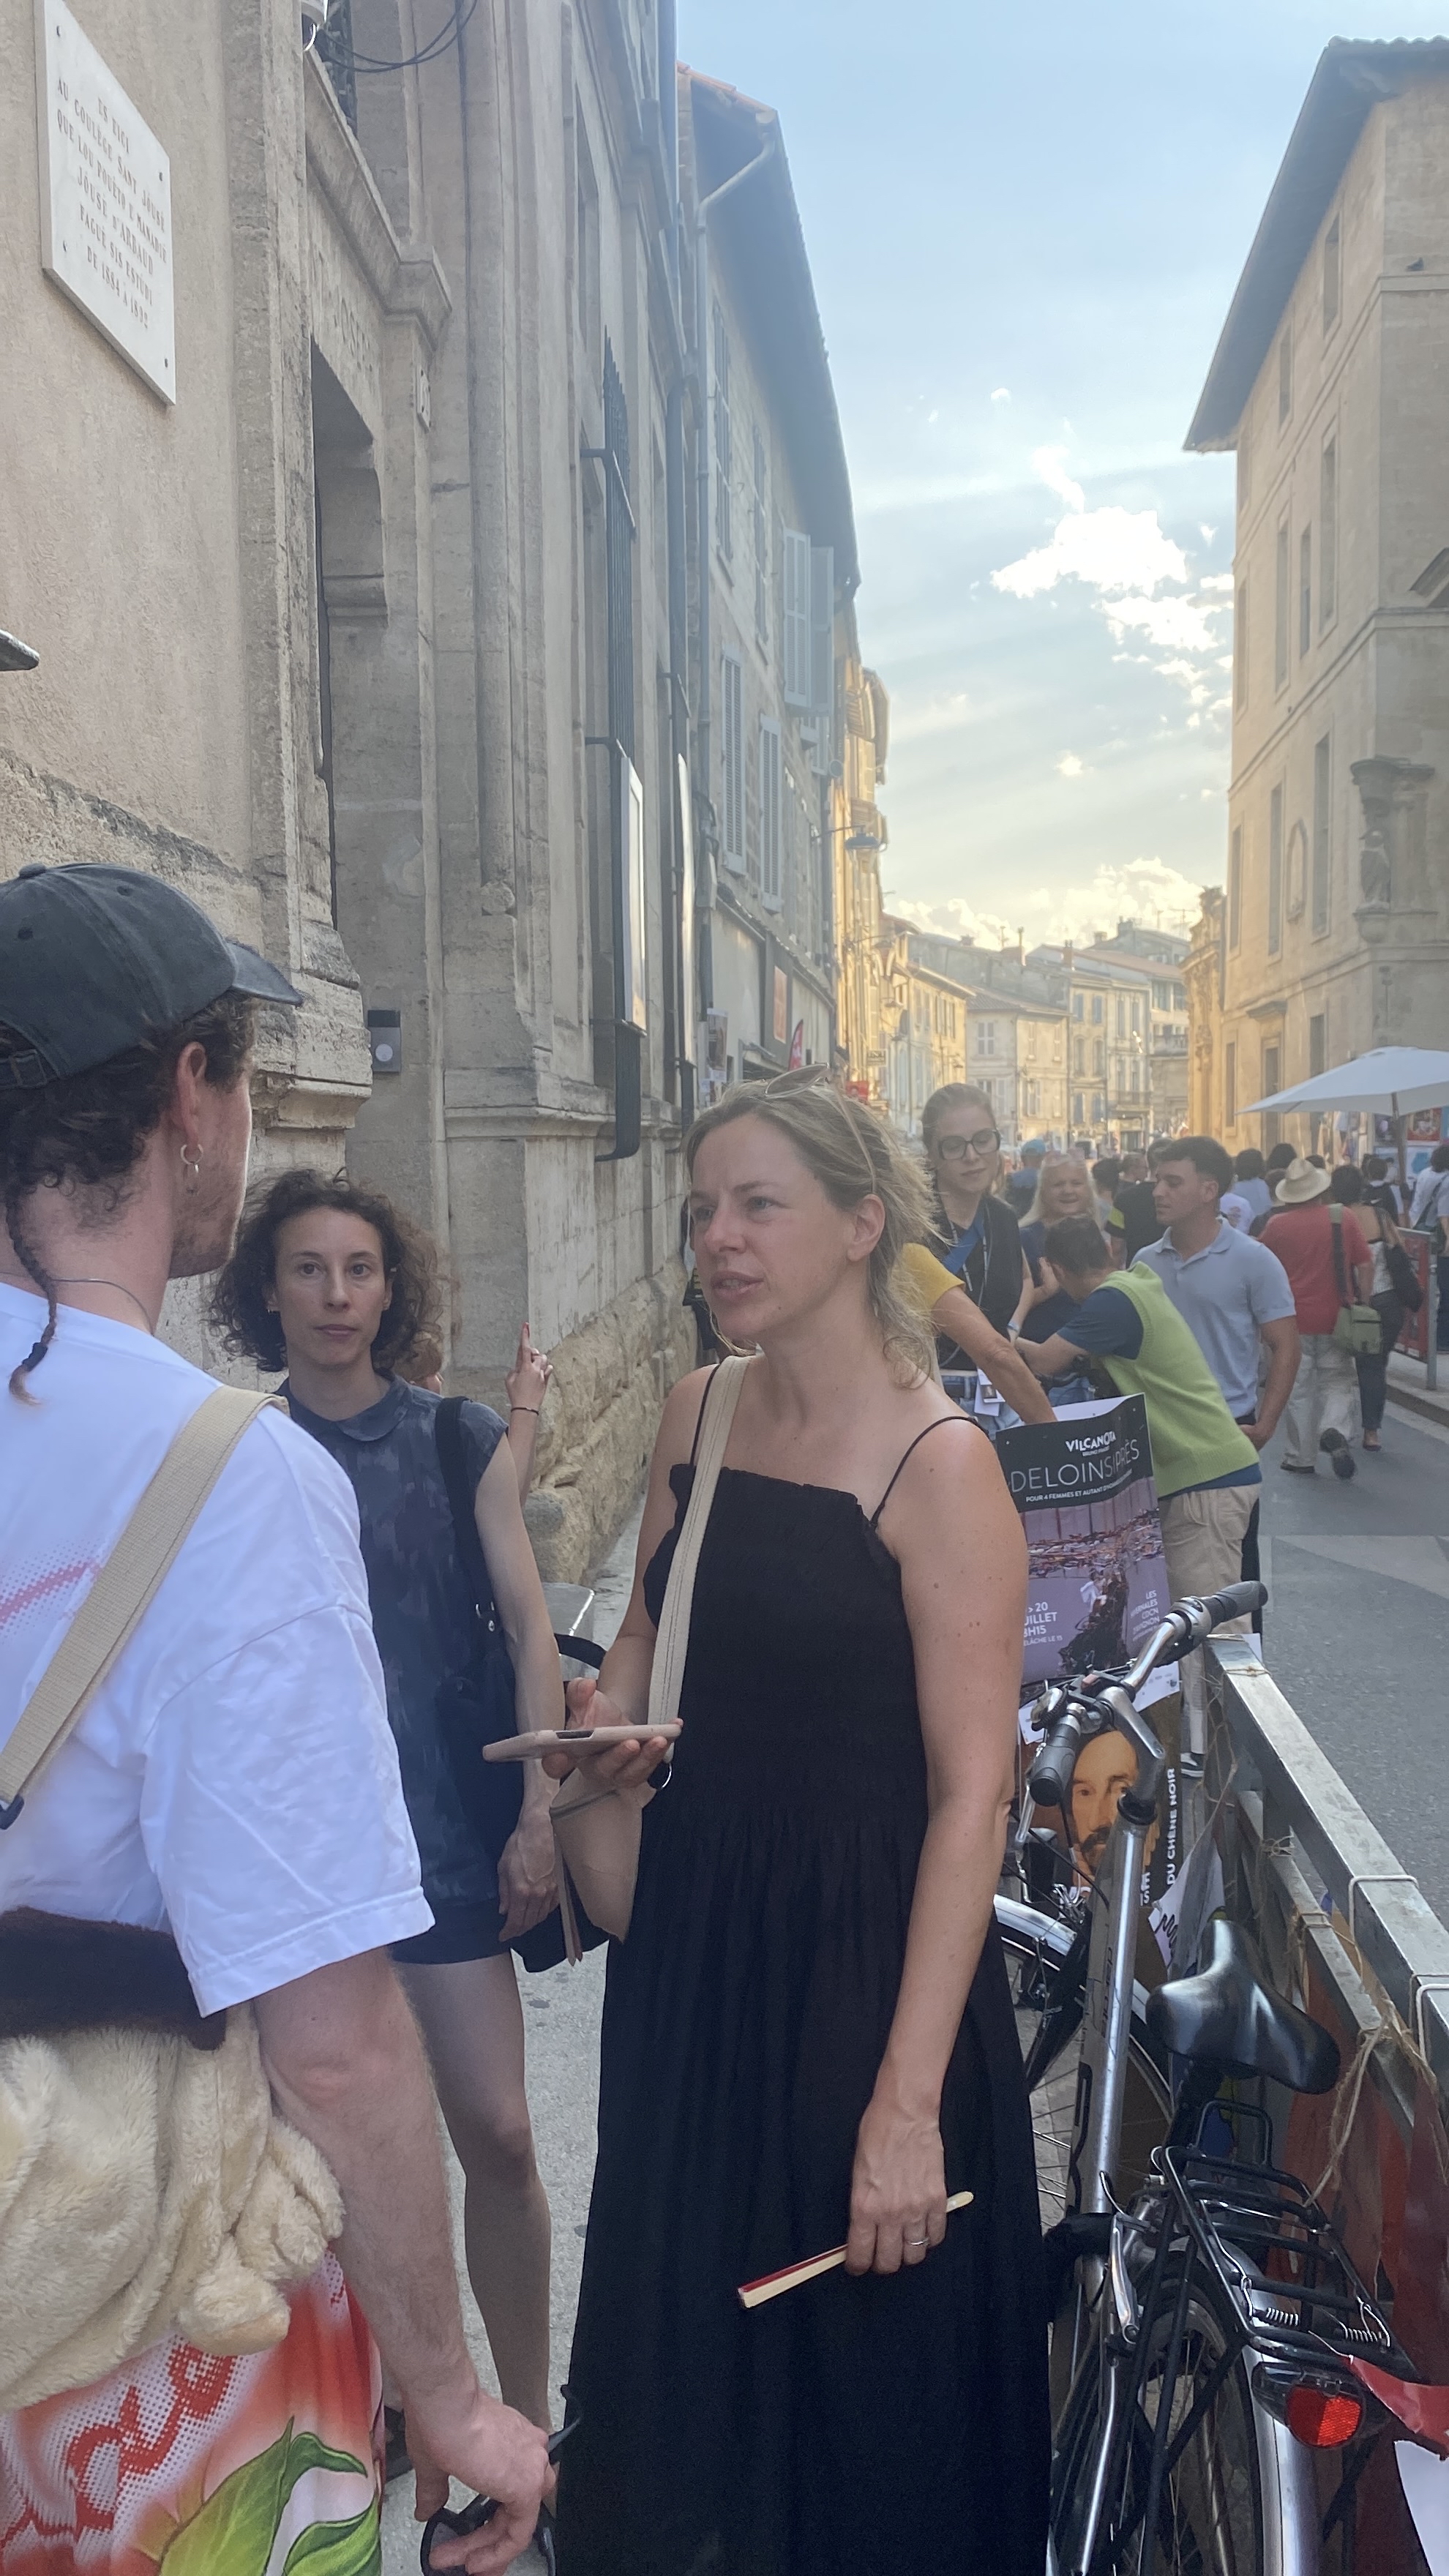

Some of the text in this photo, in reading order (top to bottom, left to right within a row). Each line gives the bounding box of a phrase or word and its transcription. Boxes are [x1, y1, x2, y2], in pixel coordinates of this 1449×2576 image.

[58, 77, 68, 101] AU
[118, 156, 136, 195] SANT
[97, 97, 129, 154] ES EICI
[57, 108, 74, 143] QUE
[78, 135, 94, 168] LOU
[110, 242, 123, 268] SIS
[87, 245, 97, 270] DE
[102, 263, 120, 297] 1884
[130, 294, 148, 329] 1892
[1066, 1431, 1116, 1453] VILCANOTA
[1049, 1491, 1074, 1499] FEMMES
[1083, 1486, 1103, 1496] AUTANT
[1035, 1601, 1049, 1612] 20
[1145, 1590, 1157, 1600] LES
[1024, 1612, 1057, 1626] UILLET
[1167, 1768, 1177, 1806] NOIR
[1167, 1863, 1176, 1886] DU
